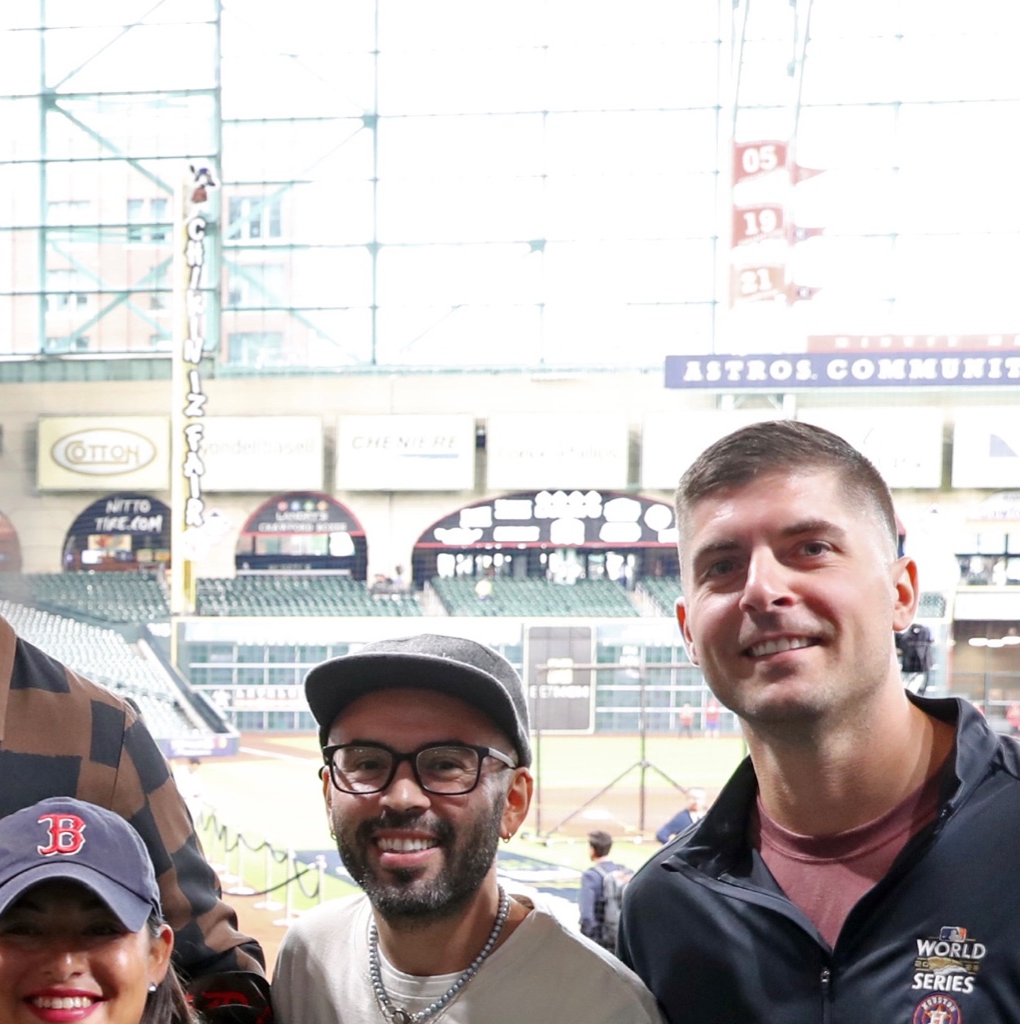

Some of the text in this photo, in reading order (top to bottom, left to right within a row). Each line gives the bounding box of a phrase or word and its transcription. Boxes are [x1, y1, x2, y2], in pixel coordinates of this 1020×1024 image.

[742, 145, 778, 174] 05
[743, 209, 777, 235] 19
[741, 268, 772, 294] 21
[683, 360, 814, 381] ASTROS
[65, 440, 140, 465] COTTON
[351, 436, 457, 450] CHENIERE
[183, 424, 206, 527] FAIR
[106, 499, 152, 514] NITTO
[37, 813, 87, 857] B
[916, 939, 986, 960] WORLD
[911, 973, 975, 994] SERIES
[921, 996, 957, 1013] HOUSTON
